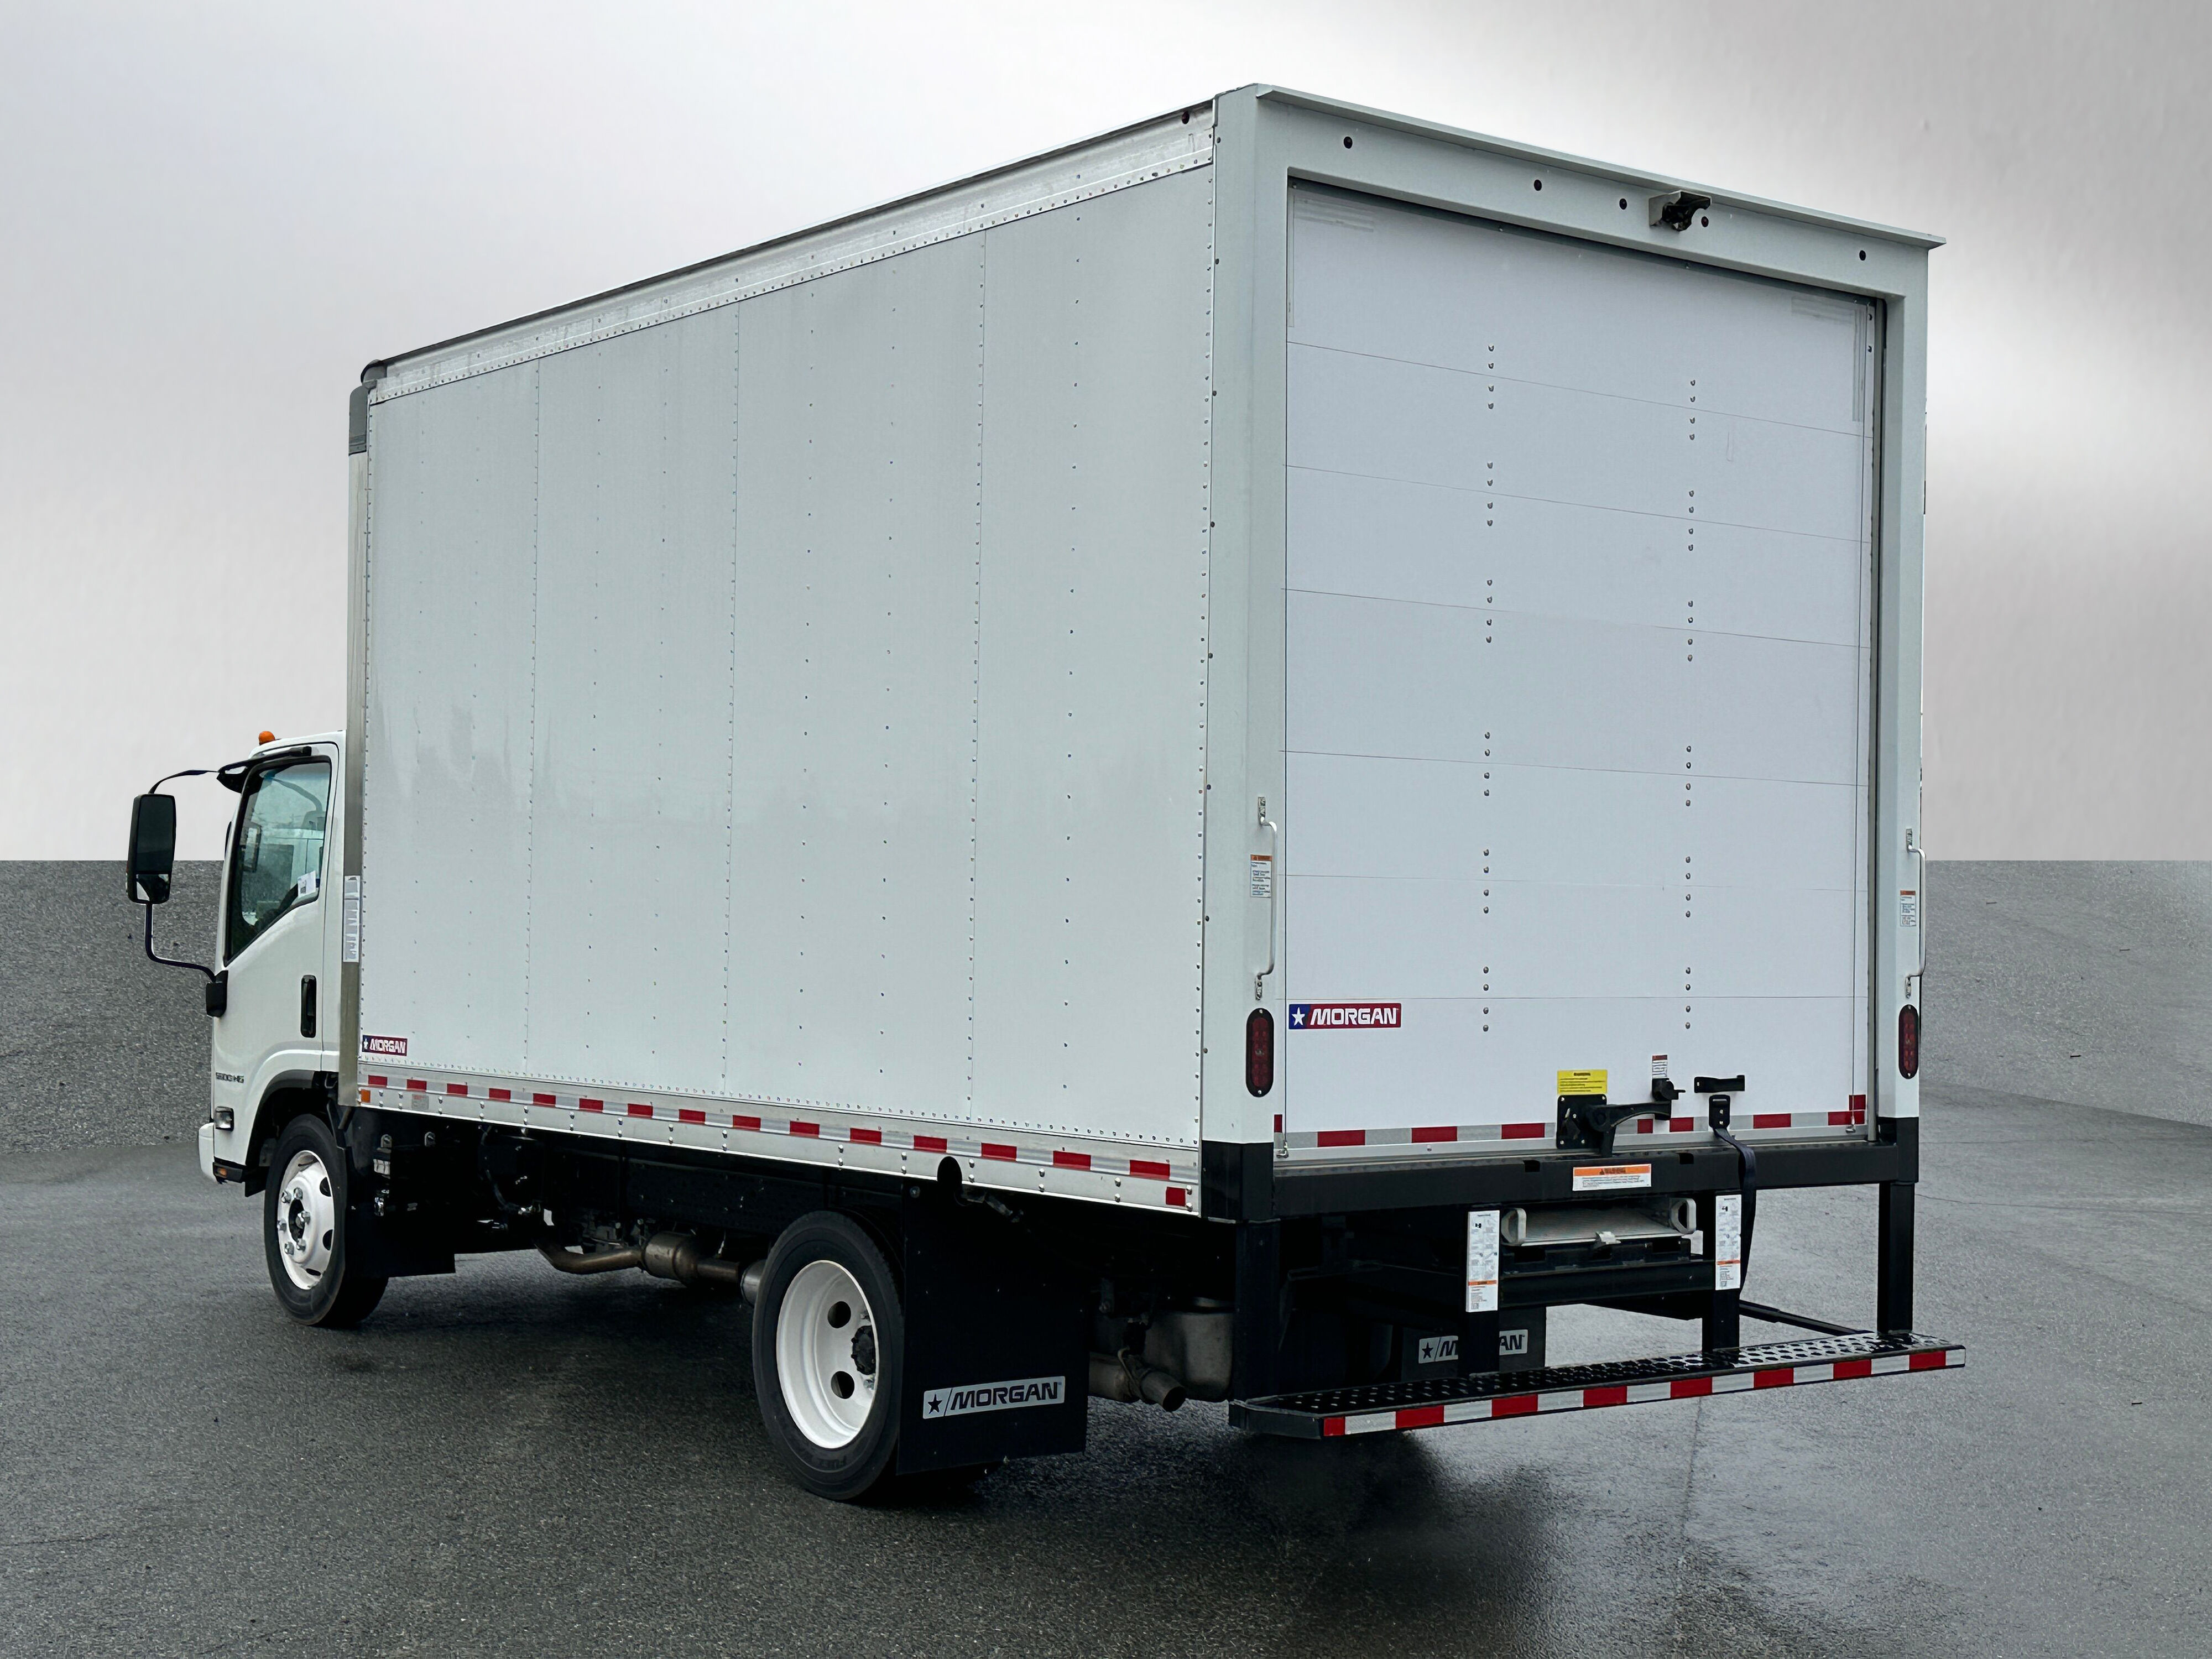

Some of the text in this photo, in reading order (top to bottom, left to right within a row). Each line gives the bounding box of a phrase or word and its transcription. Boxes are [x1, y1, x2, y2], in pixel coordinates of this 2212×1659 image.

[1310, 1008, 1397, 1025] MORGAN
[369, 1039, 406, 1053] MORGAN
[950, 1382, 1058, 1410] MORGAN
